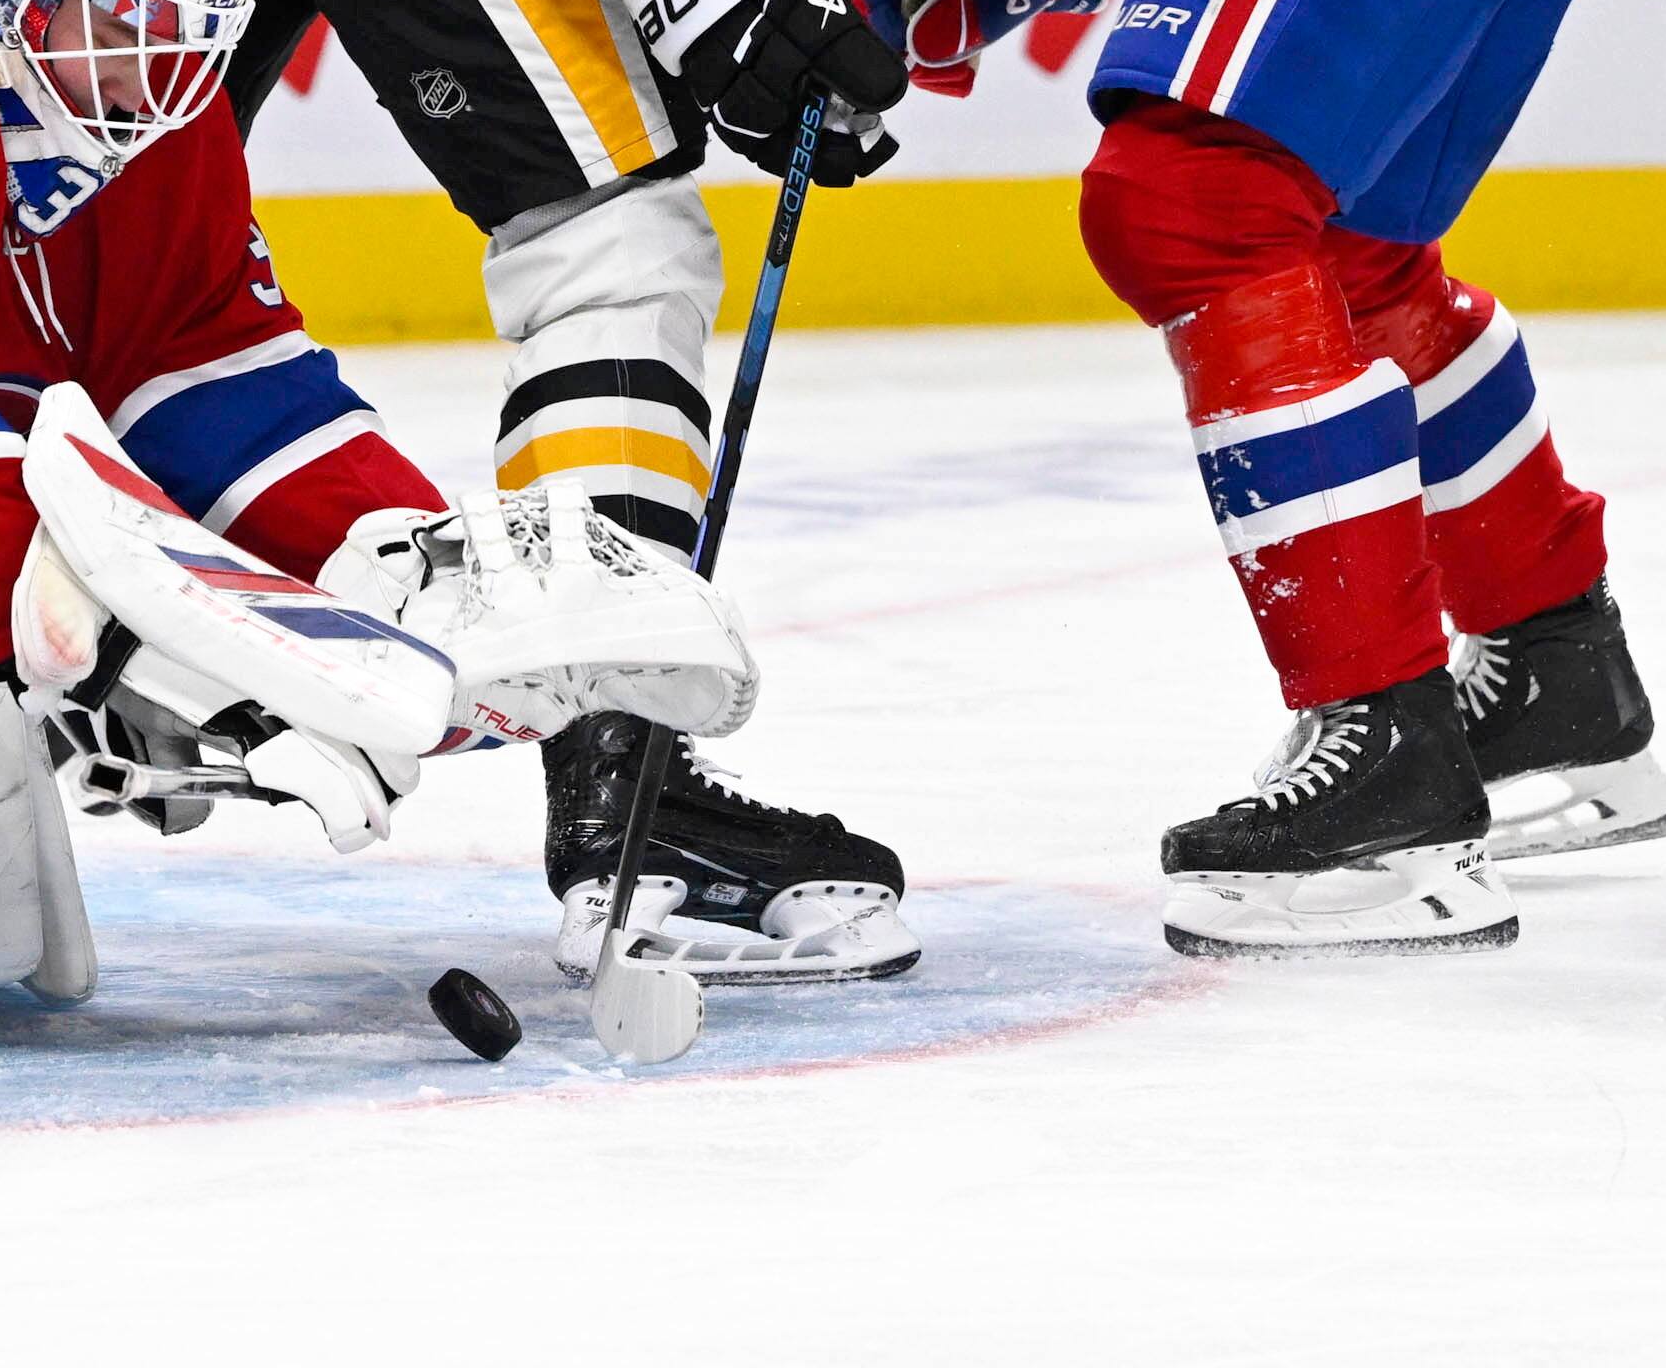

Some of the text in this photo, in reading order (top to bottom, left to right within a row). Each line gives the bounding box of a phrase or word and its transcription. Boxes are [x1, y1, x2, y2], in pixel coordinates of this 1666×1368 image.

[428, 78, 450, 109] NHL
[778, 213, 792, 243] FT7
[473, 701, 544, 741] TRUE
